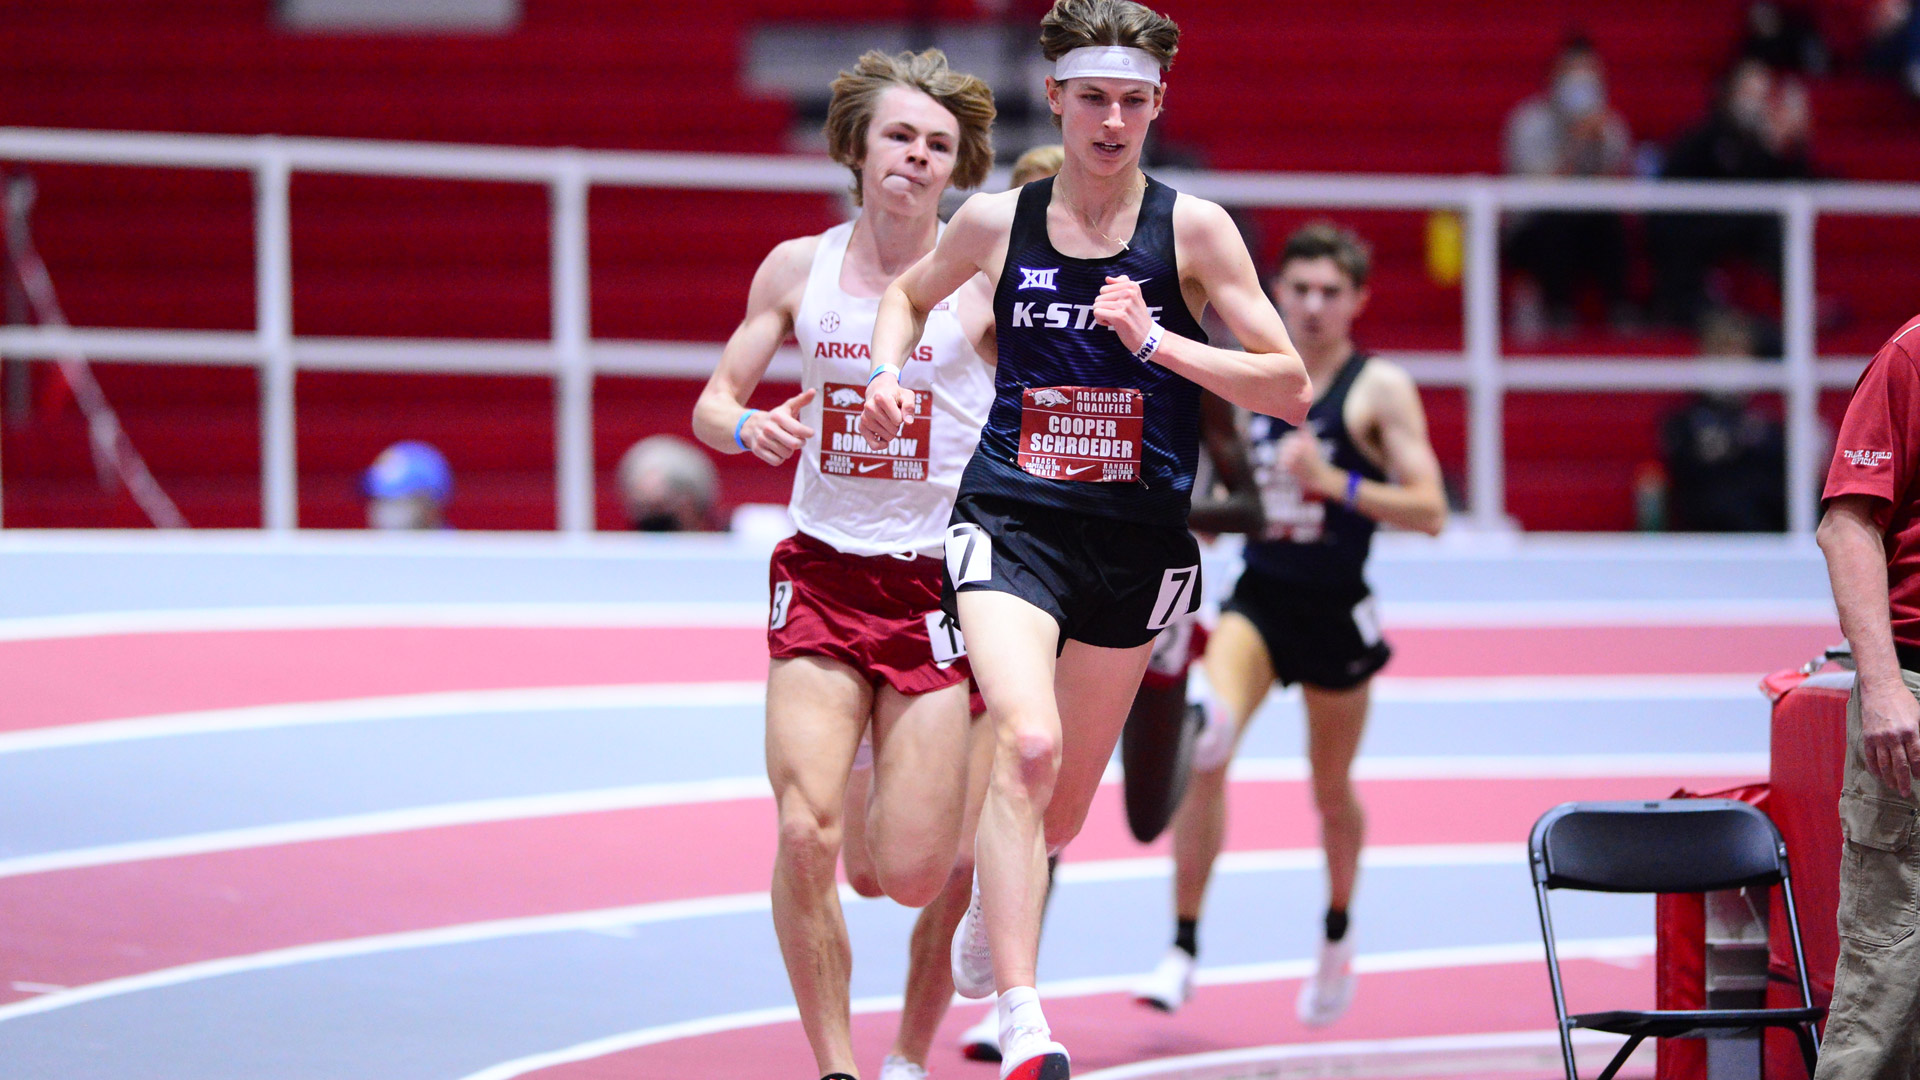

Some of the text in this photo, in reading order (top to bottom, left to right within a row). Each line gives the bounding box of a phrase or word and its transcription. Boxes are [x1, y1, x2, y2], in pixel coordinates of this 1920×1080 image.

[1018, 267, 1059, 290] XII
[1076, 391, 1132, 403] ARKANSAS
[1076, 402, 1132, 414] QUALIFIER
[1048, 416, 1117, 438] COOPER
[1030, 433, 1133, 458] SCHROEDER
[1871, 451, 1892, 460] FIELD
[1031, 456, 1057, 465] TRACK
[1029, 468, 1056, 477] WORLD
[952, 526, 980, 581] 7
[772, 585, 786, 626] 3
[1158, 571, 1191, 625] 7
